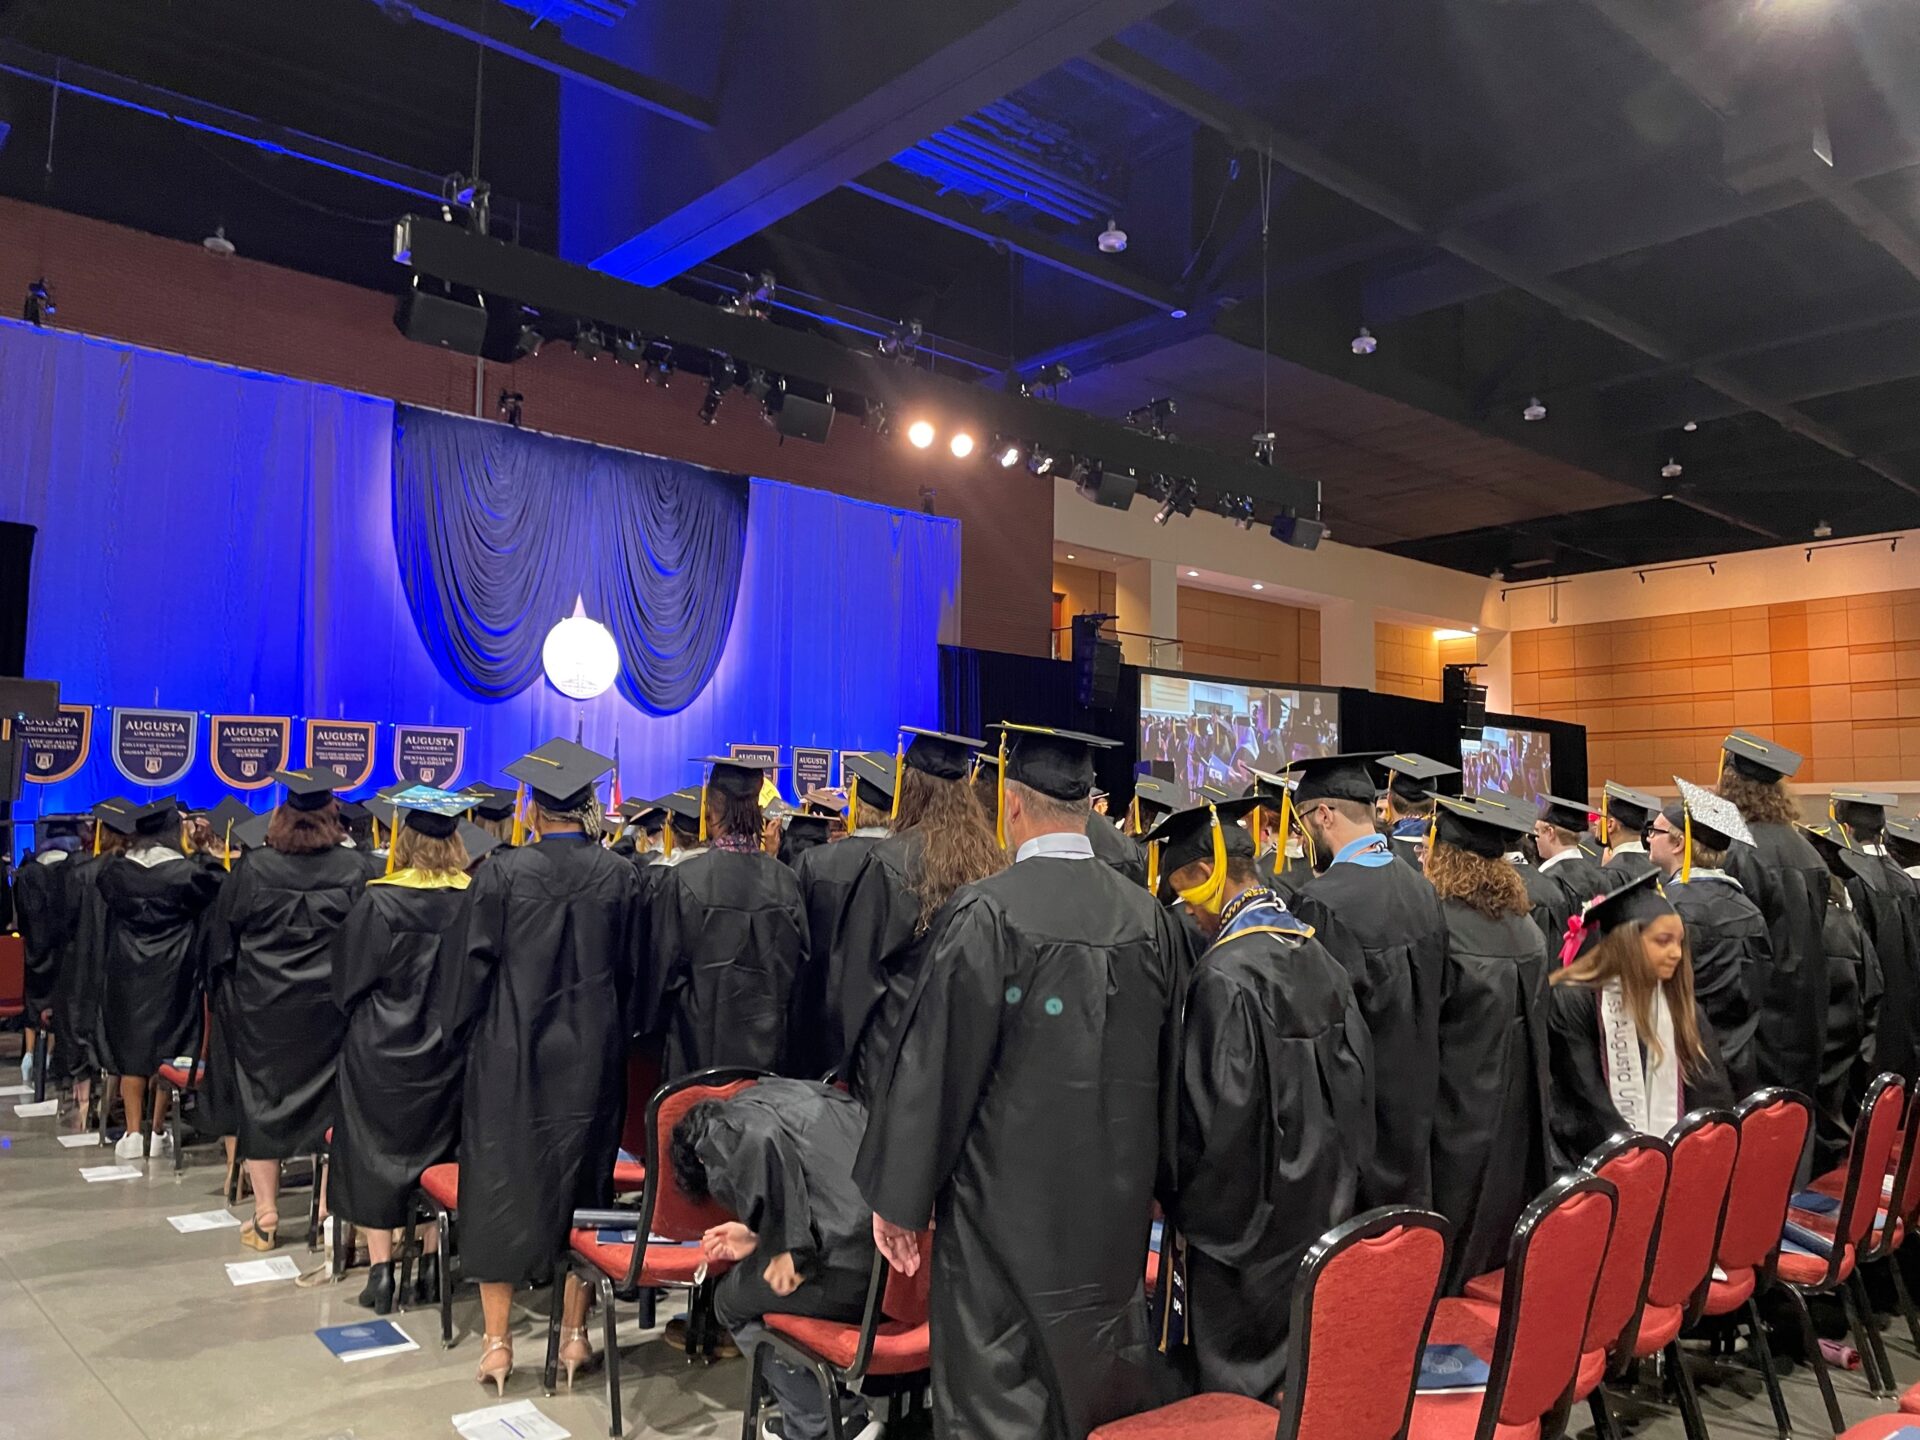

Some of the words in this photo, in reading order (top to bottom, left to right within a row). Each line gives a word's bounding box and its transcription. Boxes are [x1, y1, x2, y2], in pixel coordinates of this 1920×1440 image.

[126, 721, 185, 733] AUGUSTA
[224, 728, 278, 737] AUGUSTA
[317, 732, 365, 741] AUGUSTA
[405, 737, 454, 746] AUGUSTA
[1610, 1019, 1632, 1082] Augusta
